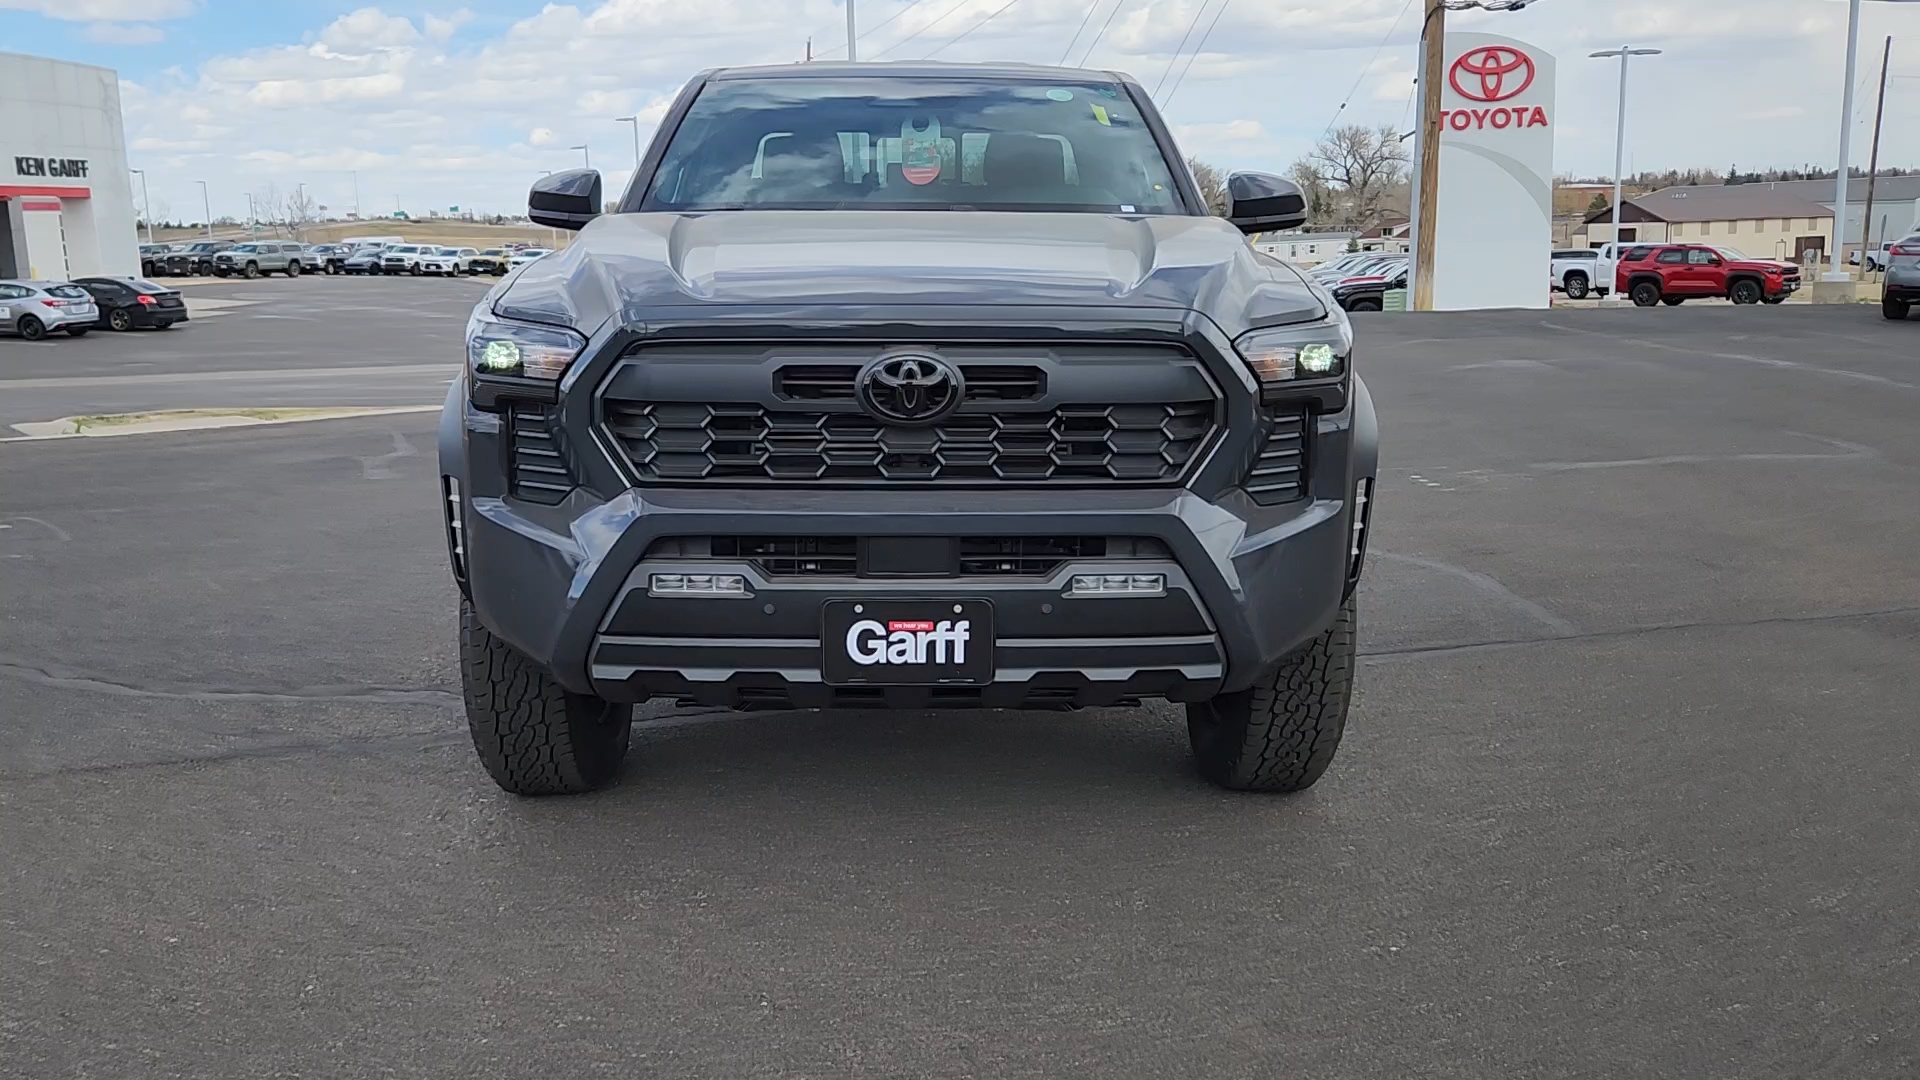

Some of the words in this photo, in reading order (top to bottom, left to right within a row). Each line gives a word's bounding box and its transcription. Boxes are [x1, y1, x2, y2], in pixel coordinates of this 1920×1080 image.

[1439, 106, 1548, 131] TOYOTA
[15, 156, 46, 176] KEN
[48, 158, 89, 178] GARFF
[846, 619, 970, 665] Garff
